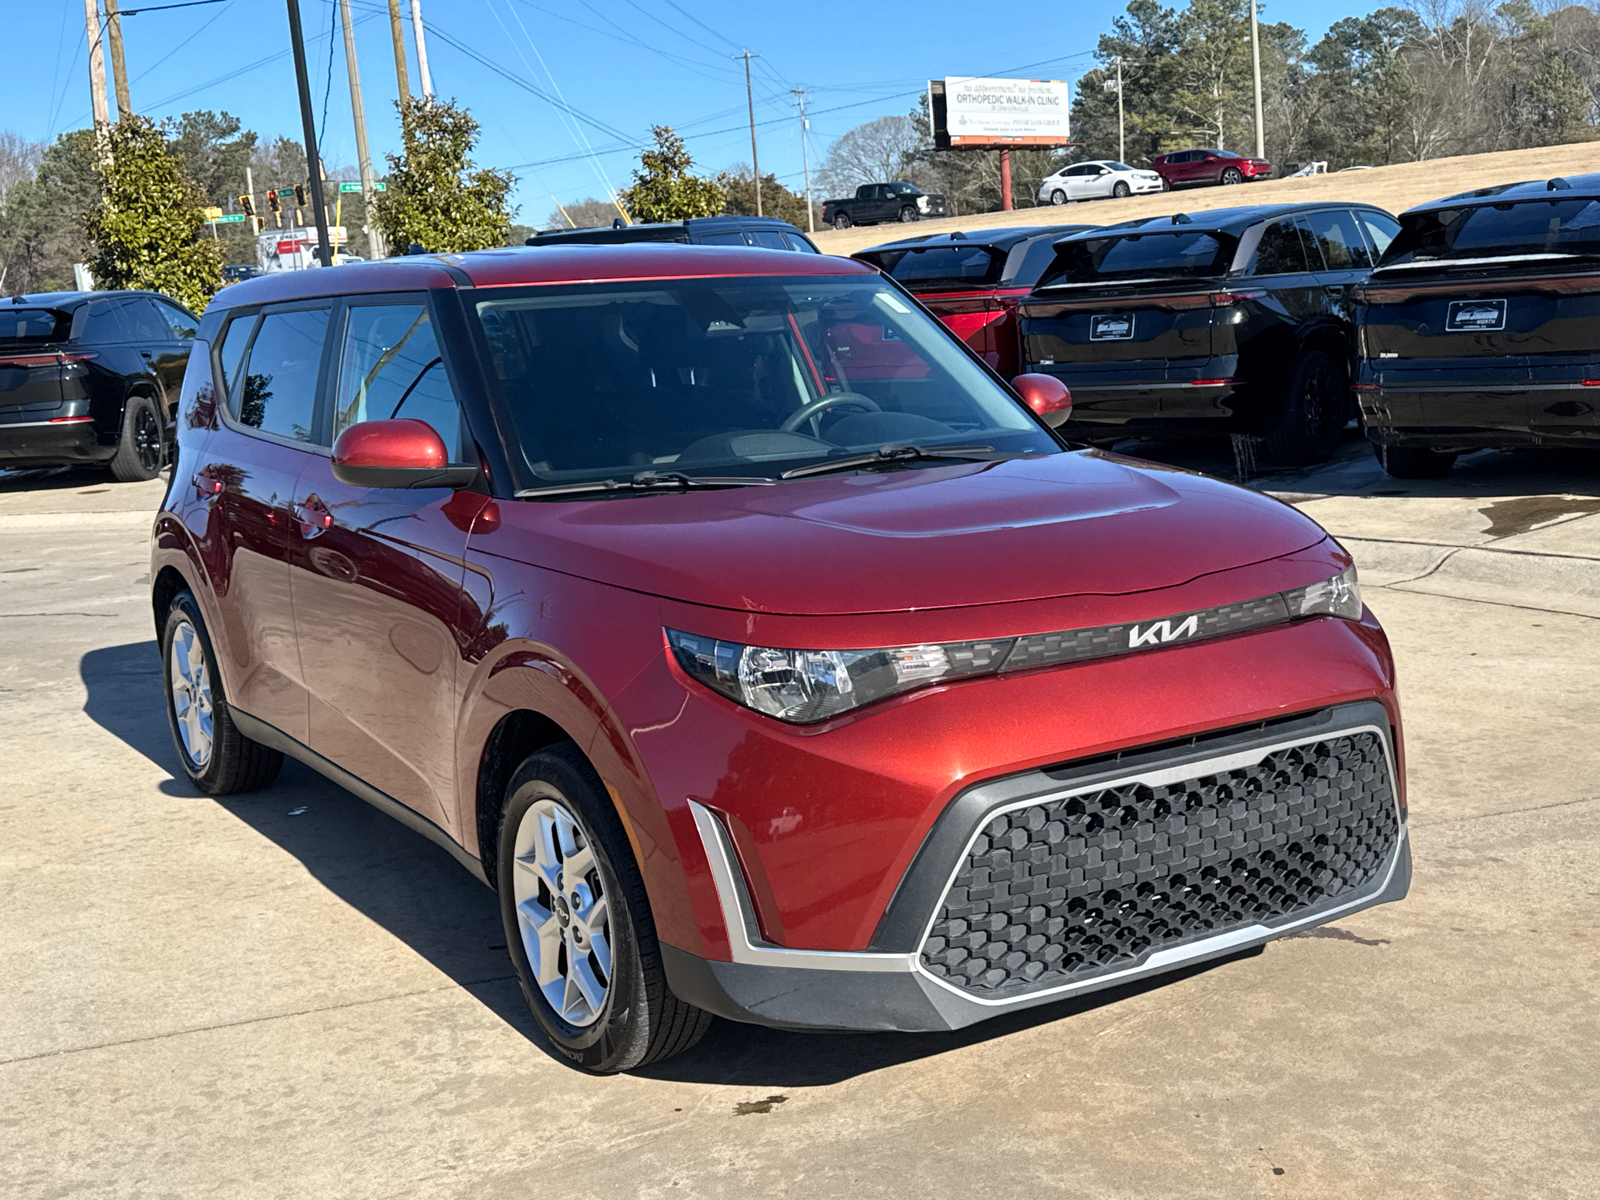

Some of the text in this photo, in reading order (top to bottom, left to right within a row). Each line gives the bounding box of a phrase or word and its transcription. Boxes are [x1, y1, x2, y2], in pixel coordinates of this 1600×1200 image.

[957, 94, 1060, 106] ORTHOPEDIC WALK-IN CLINIC
[1129, 615, 1198, 648] KIA
